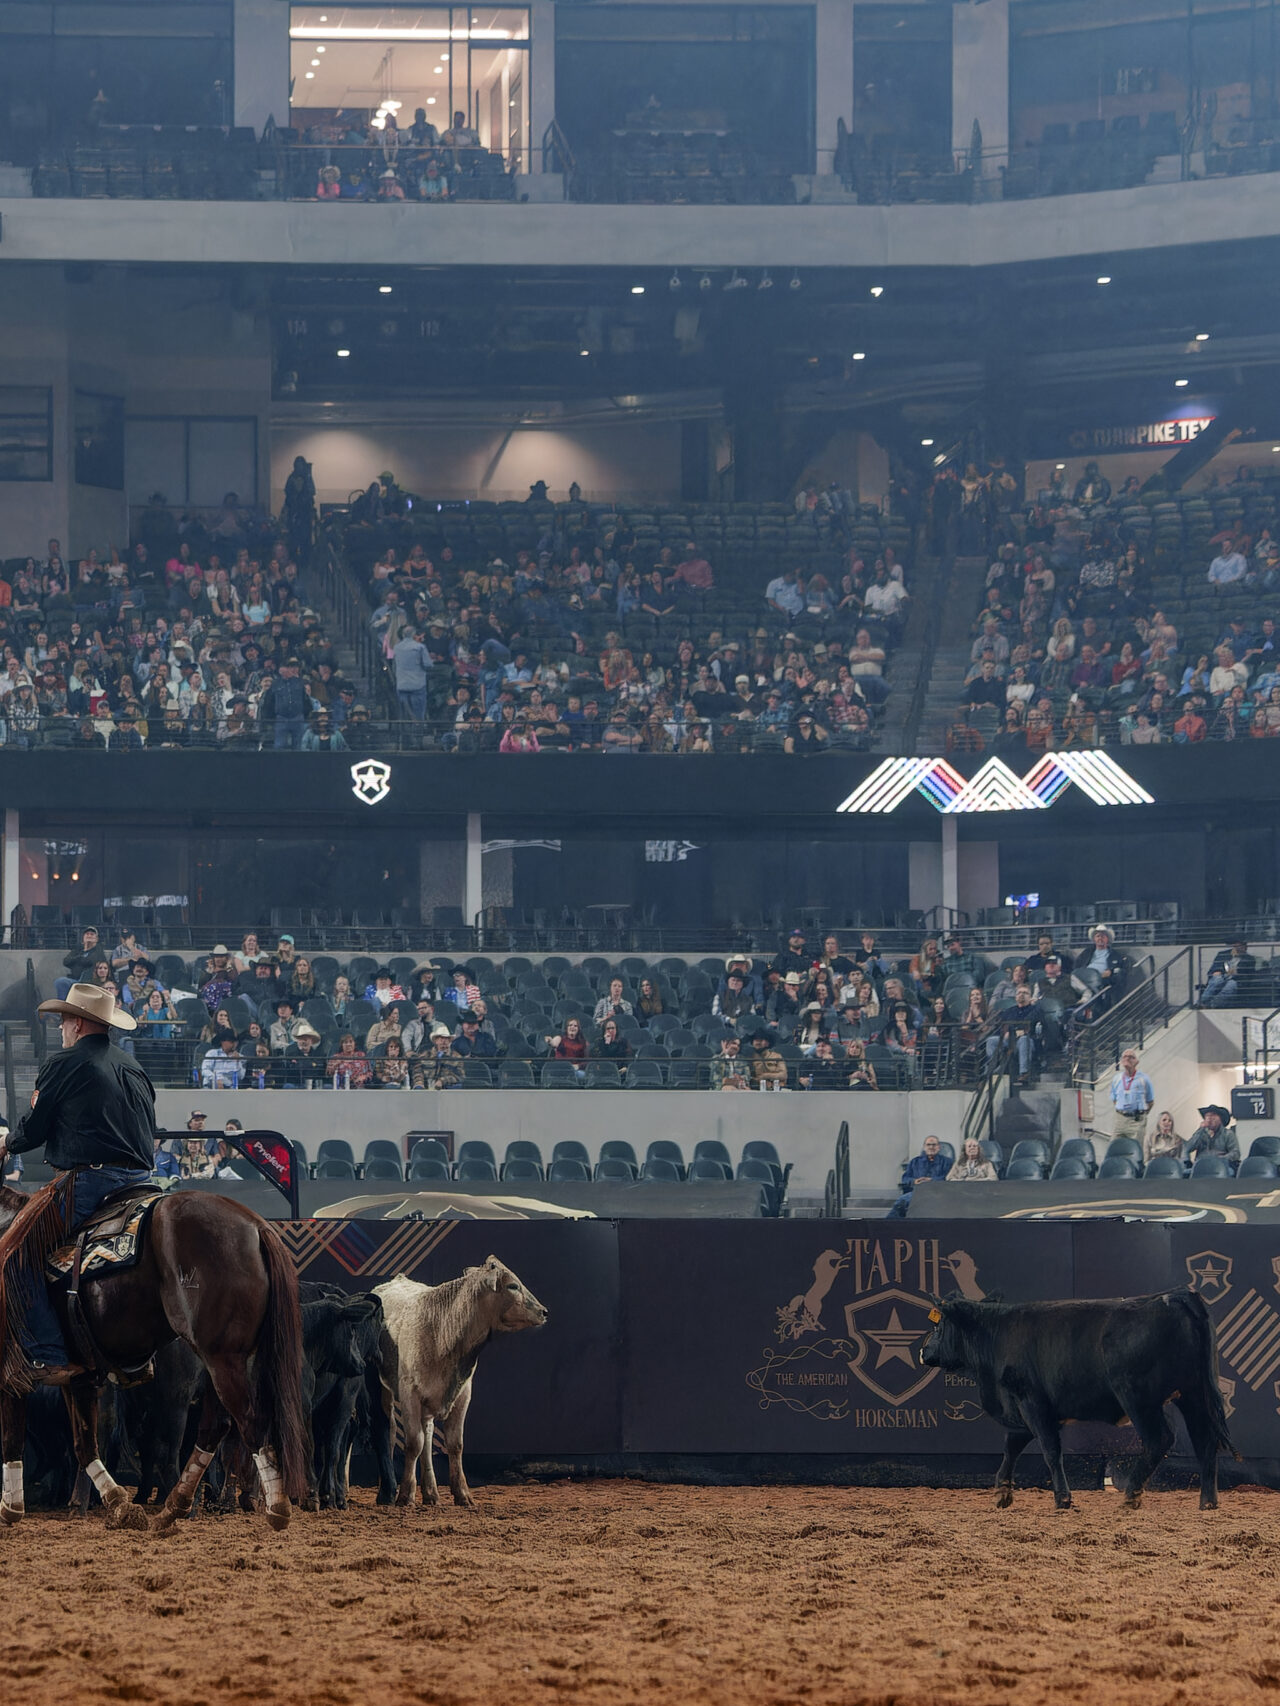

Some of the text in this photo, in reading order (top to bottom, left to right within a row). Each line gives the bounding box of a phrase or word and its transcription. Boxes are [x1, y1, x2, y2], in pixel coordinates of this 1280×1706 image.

[1253, 1102, 1266, 1115] 12
[253, 1141, 286, 1173] Priefert
[846, 1239, 941, 1298] TAPH
[776, 1372, 795, 1386] THE
[798, 1372, 848, 1386] AMERICAN
[855, 1408, 938, 1428] HORSEMAN
